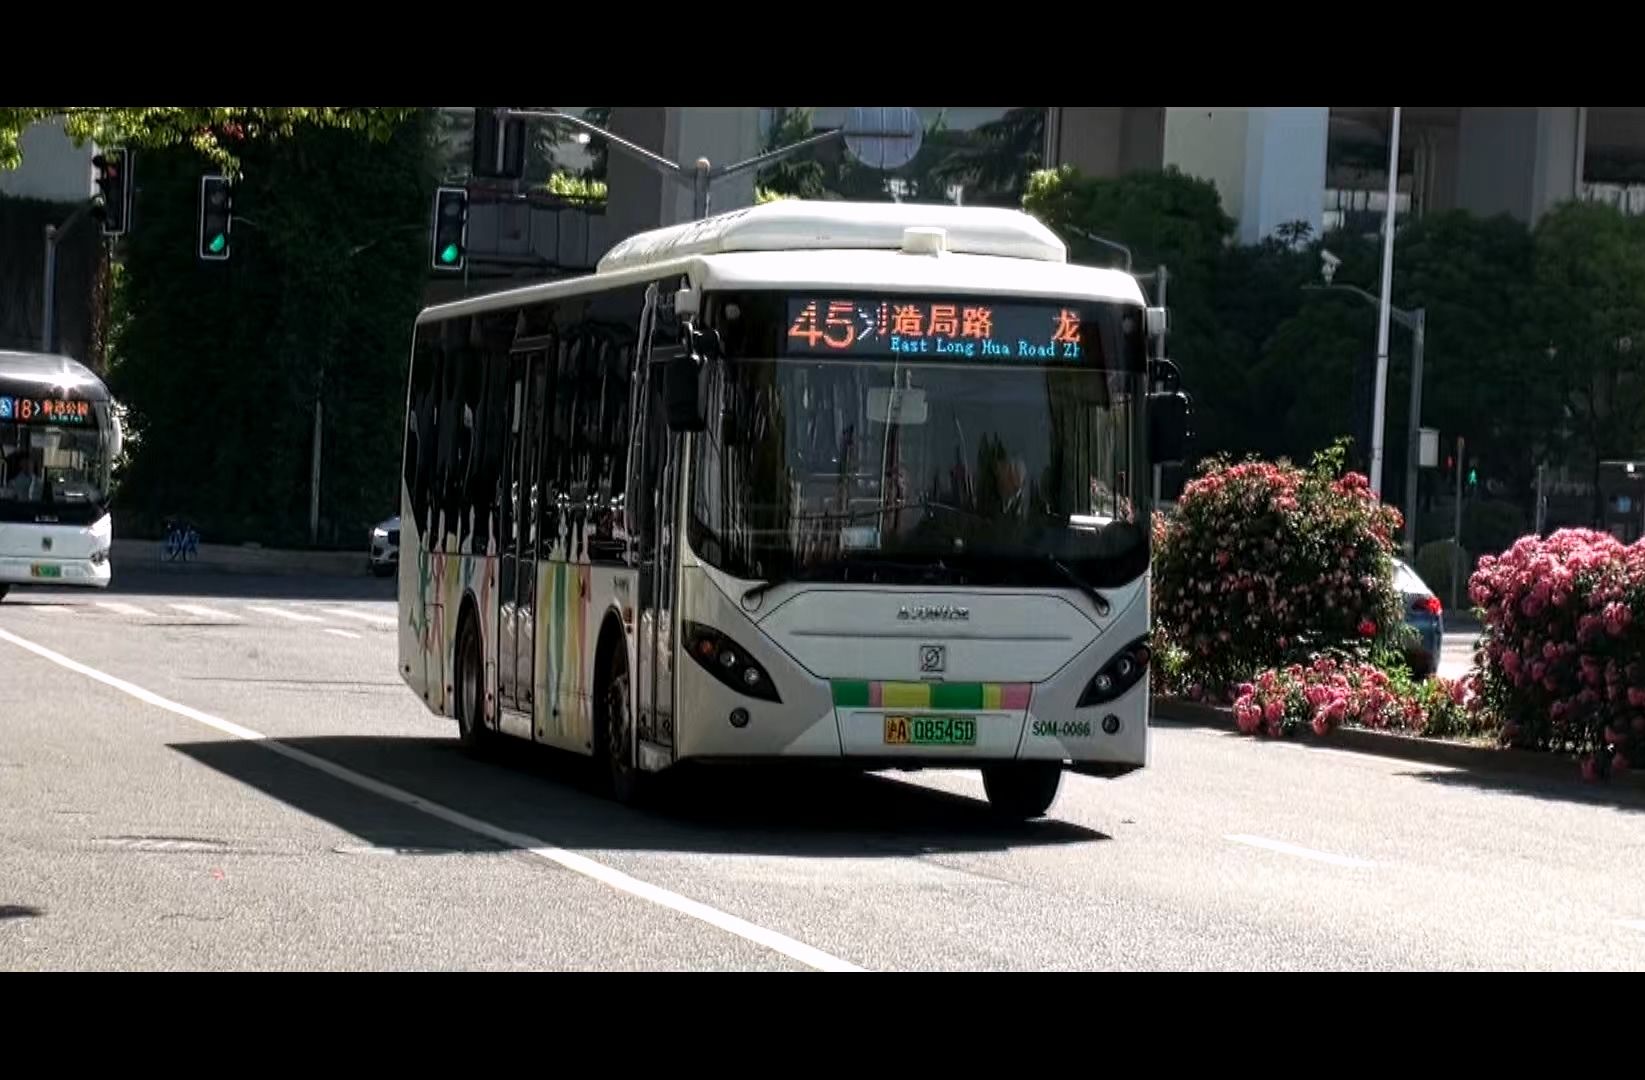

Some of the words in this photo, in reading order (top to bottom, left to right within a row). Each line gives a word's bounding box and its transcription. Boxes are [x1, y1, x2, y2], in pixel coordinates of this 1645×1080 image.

[788, 300, 855, 348] 45
[1051, 308, 1081, 342] 龙
[890, 335, 928, 353] East
[935, 337, 976, 357] Long
[981, 339, 1010, 355] Hua
[1018, 341, 1055, 357] Road
[14, 399, 32, 419] 18
